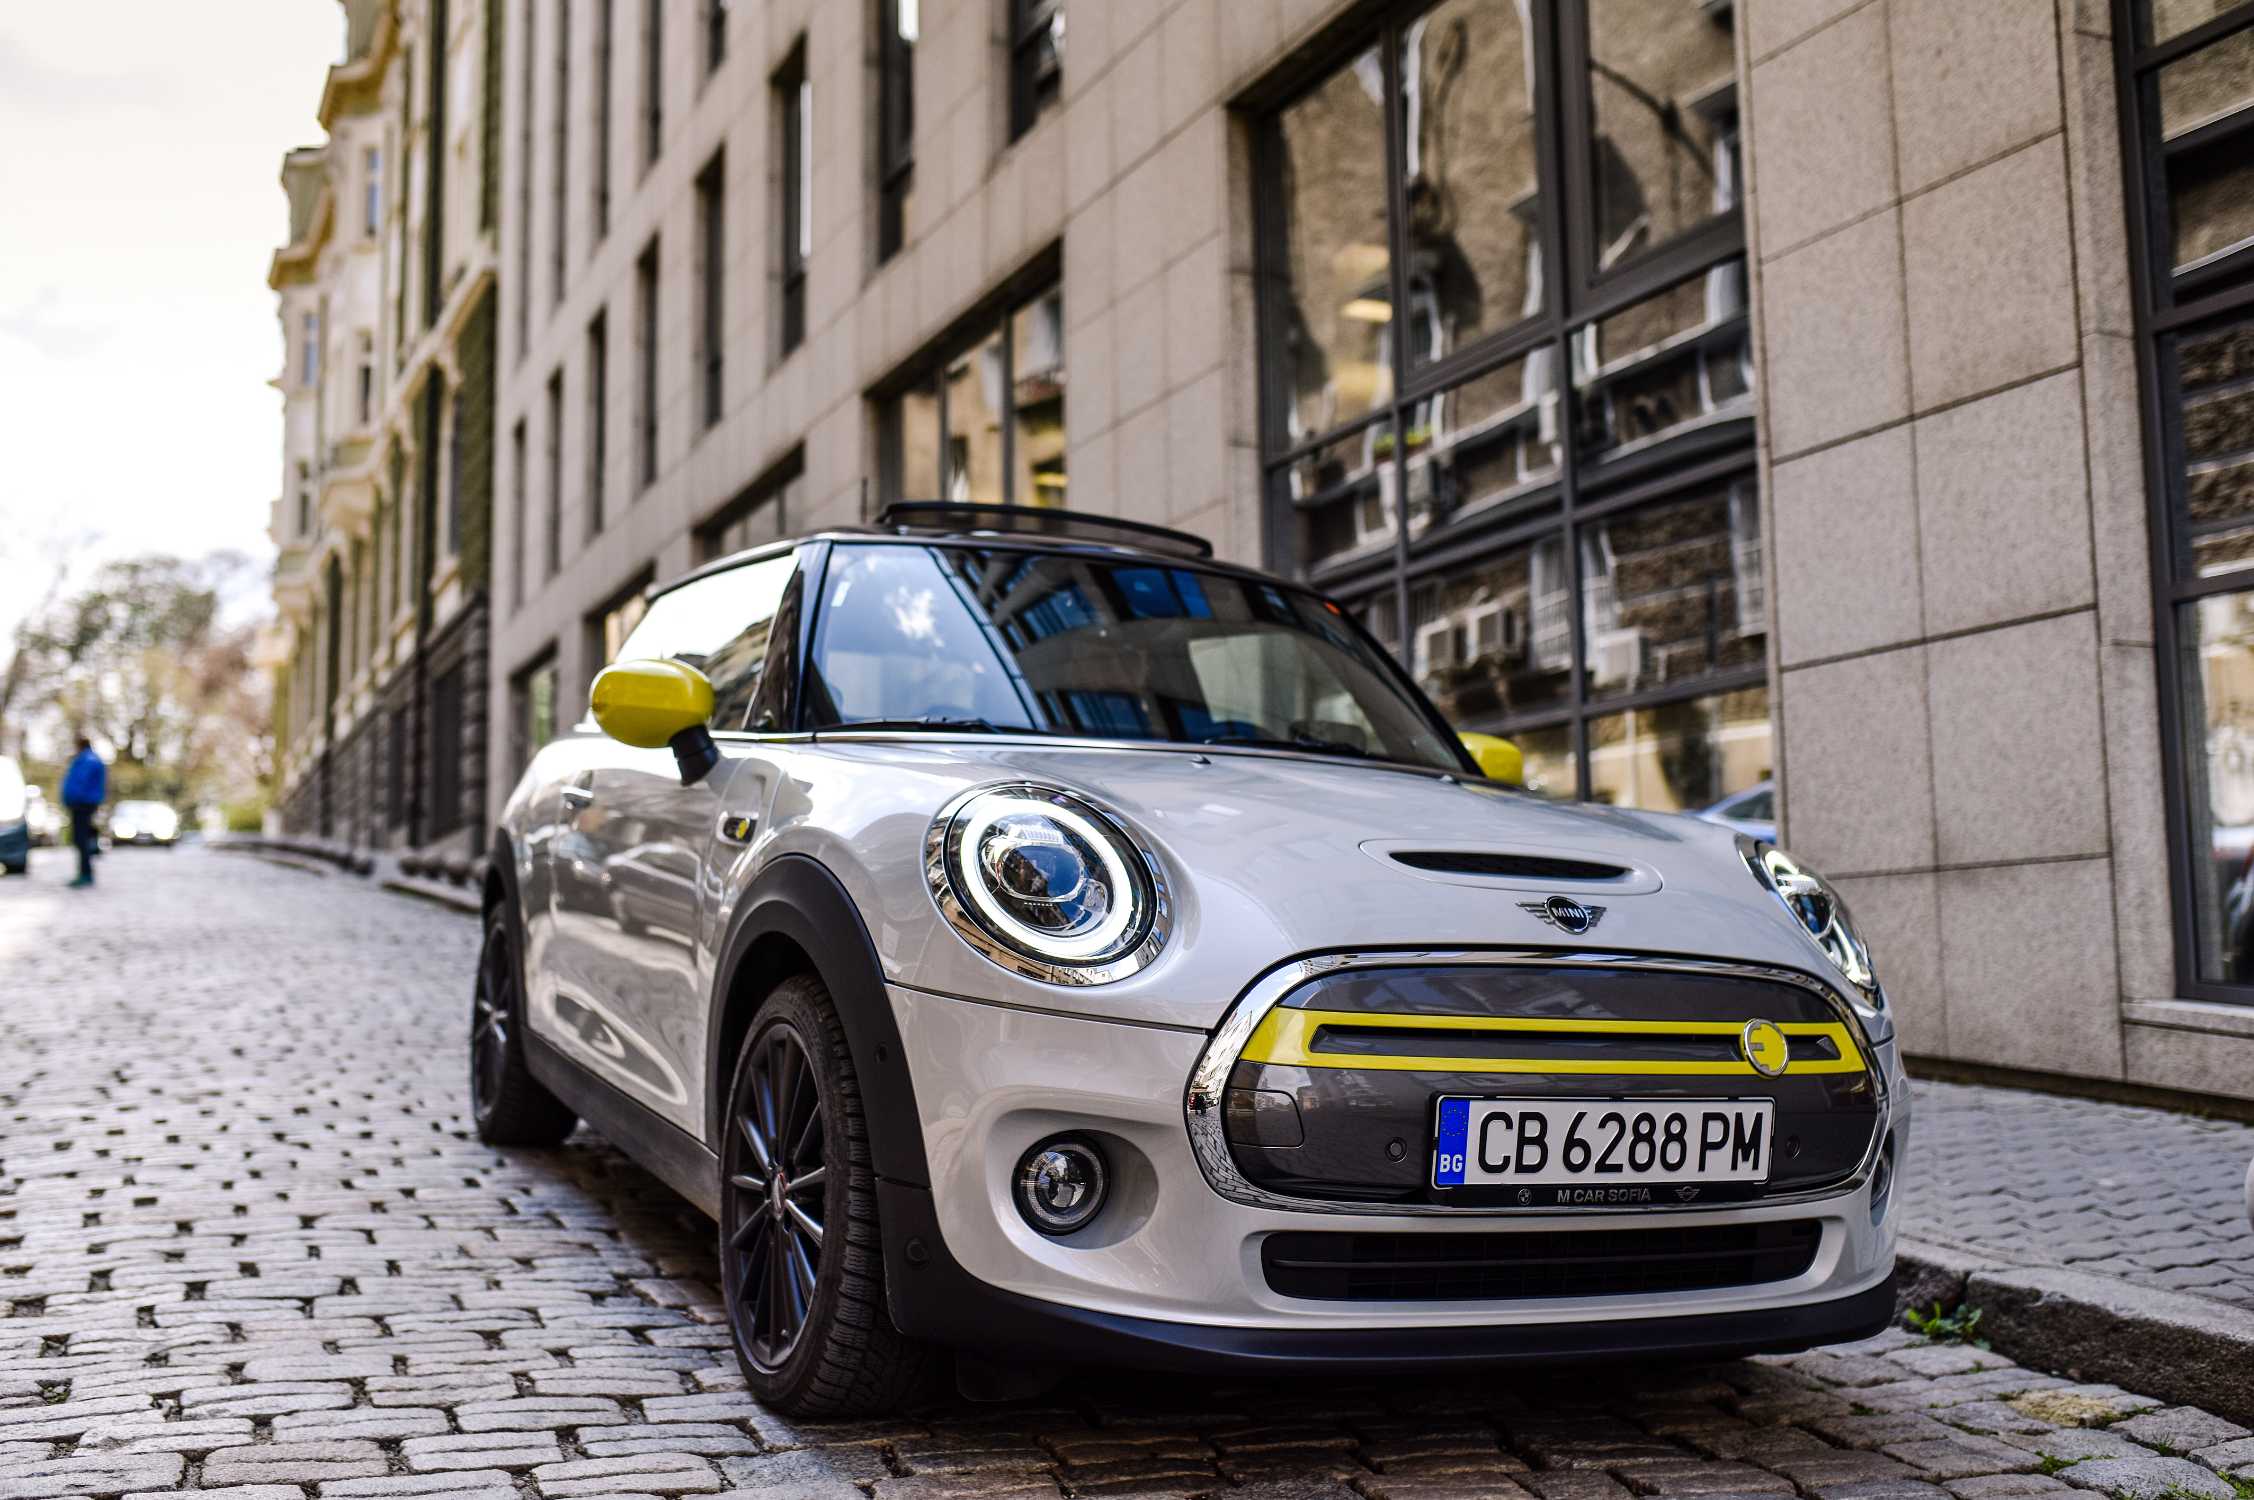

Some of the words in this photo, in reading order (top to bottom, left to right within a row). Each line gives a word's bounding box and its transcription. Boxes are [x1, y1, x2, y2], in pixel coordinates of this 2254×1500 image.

[1551, 907, 1584, 918] MINI
[1477, 1111, 1549, 1174] CB
[1562, 1111, 1688, 1174] 6288
[1698, 1111, 1764, 1173] PM
[1439, 1153, 1464, 1173] BG
[1557, 1189, 1571, 1203] M
[1573, 1188, 1604, 1203] CAR
[1607, 1187, 1652, 1202] SOFIA
